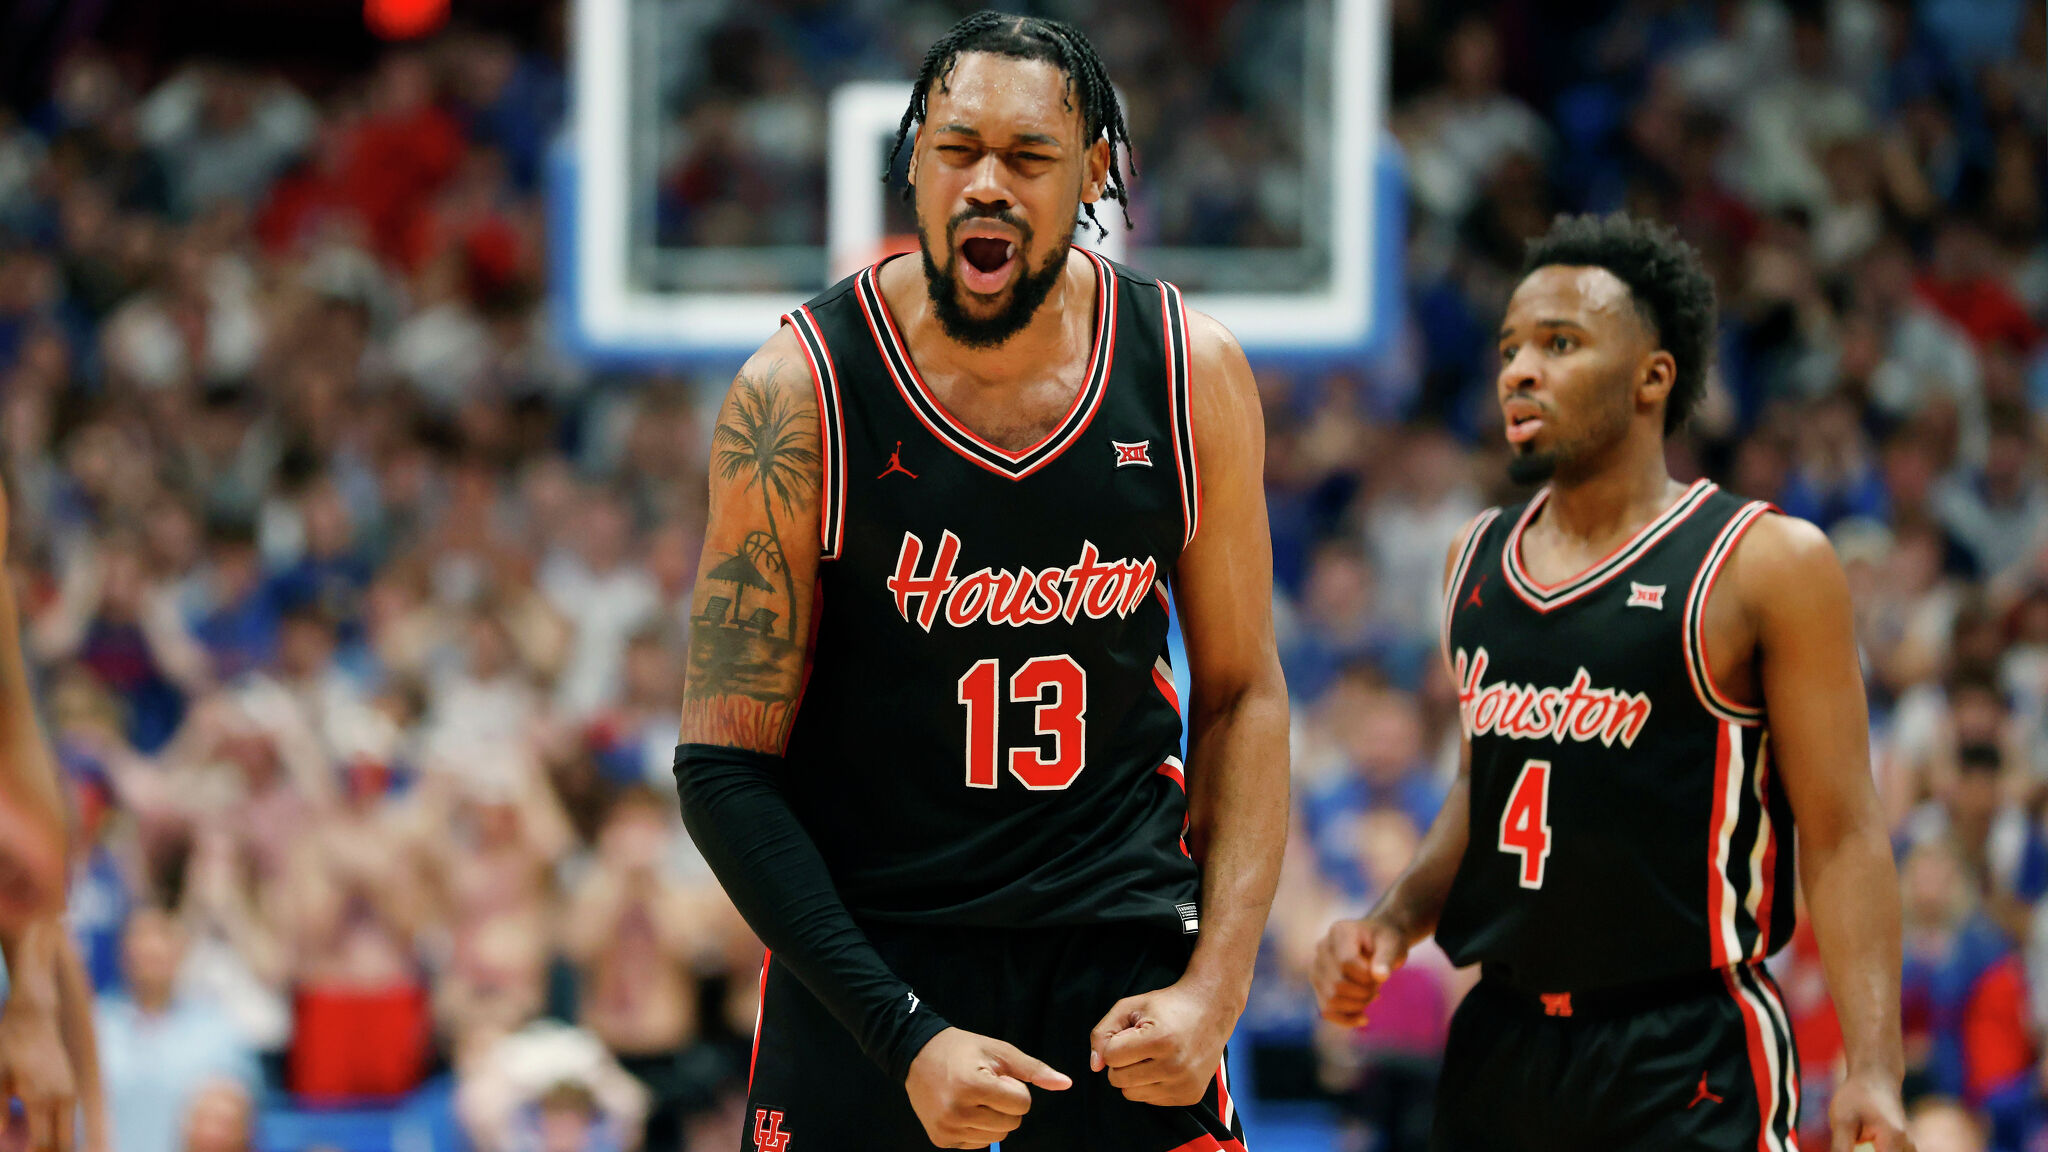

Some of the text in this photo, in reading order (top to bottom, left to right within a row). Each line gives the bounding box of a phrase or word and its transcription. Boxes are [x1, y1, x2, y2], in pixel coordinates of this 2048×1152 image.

[1116, 445, 1149, 463] XII
[887, 529, 1157, 633] Houston
[958, 654, 1086, 791] 13
[1456, 646, 1652, 749] Houston
[1498, 759, 1552, 890] 4
